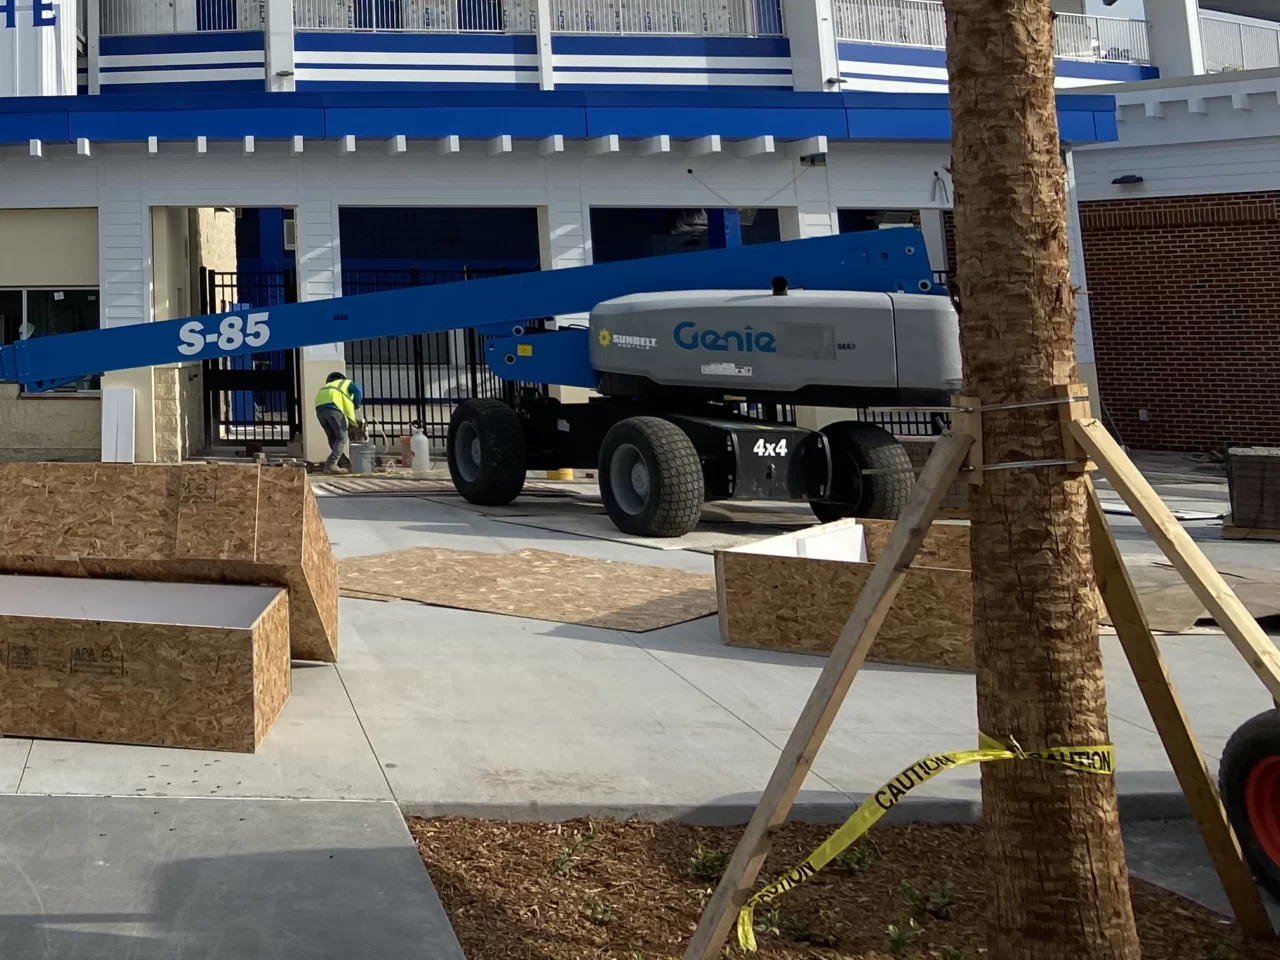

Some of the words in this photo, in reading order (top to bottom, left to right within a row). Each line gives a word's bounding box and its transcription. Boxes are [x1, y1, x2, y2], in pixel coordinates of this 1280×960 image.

[177, 311, 271, 356] S-85
[612, 334, 658, 347] SUNBELT
[673, 321, 776, 353] Genie
[752, 438, 788, 457] 4x4
[873, 755, 957, 811] CAUTION
